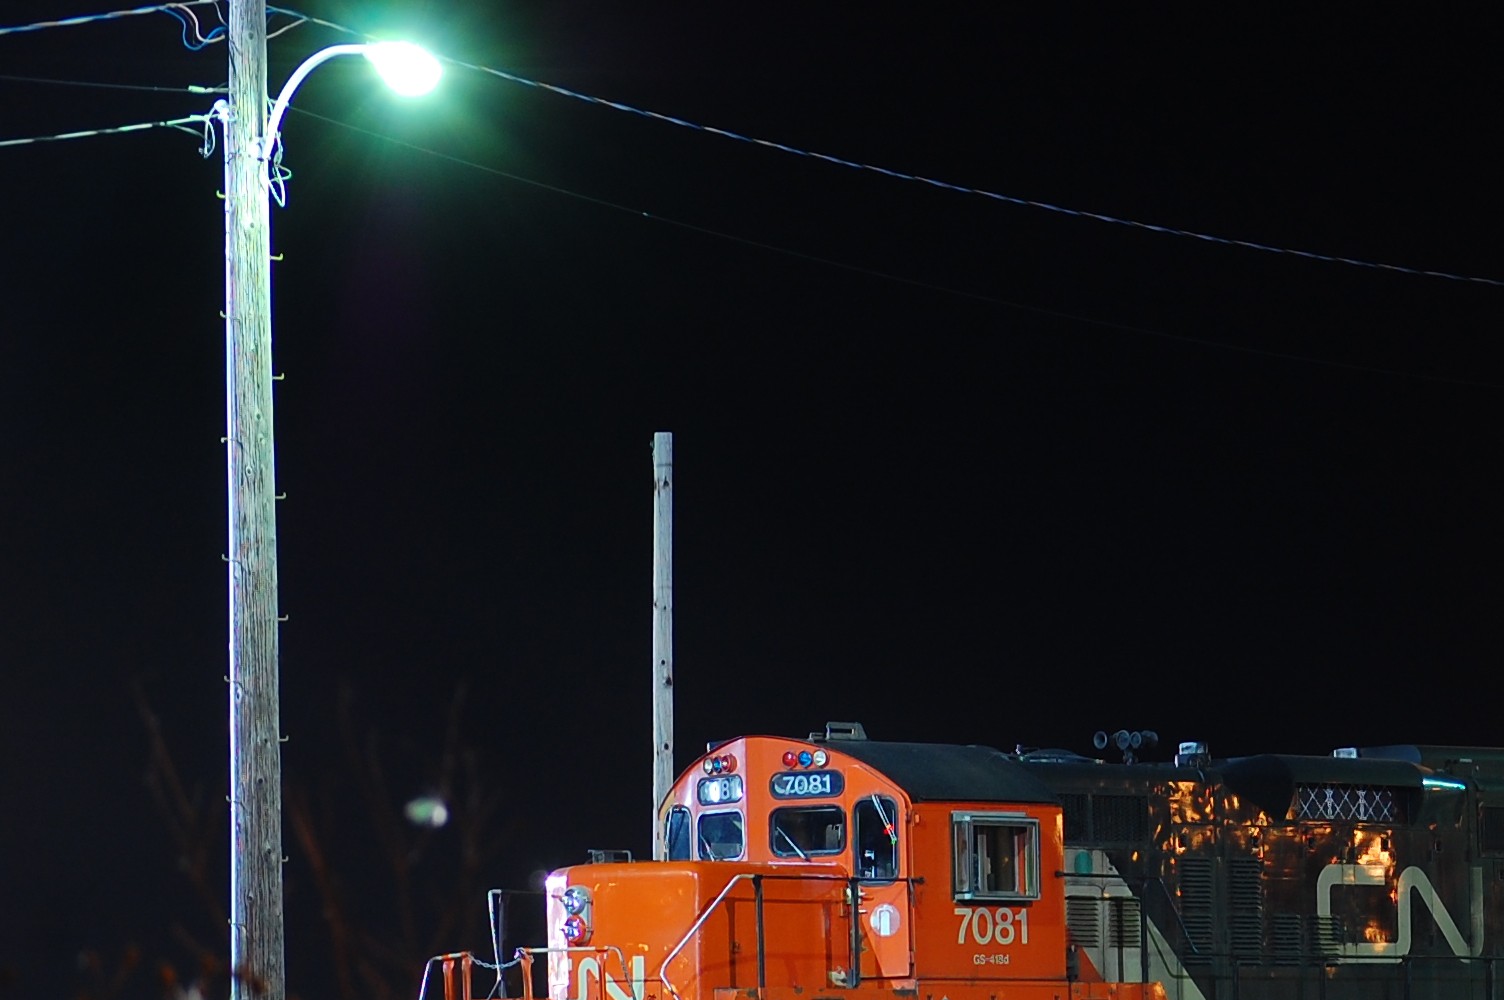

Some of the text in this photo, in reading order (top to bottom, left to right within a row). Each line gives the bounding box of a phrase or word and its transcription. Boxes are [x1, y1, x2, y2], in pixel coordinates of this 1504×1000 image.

[782, 774, 831, 795] 7081
[954, 907, 1028, 945] 7081
[1317, 864, 1484, 964] CN
